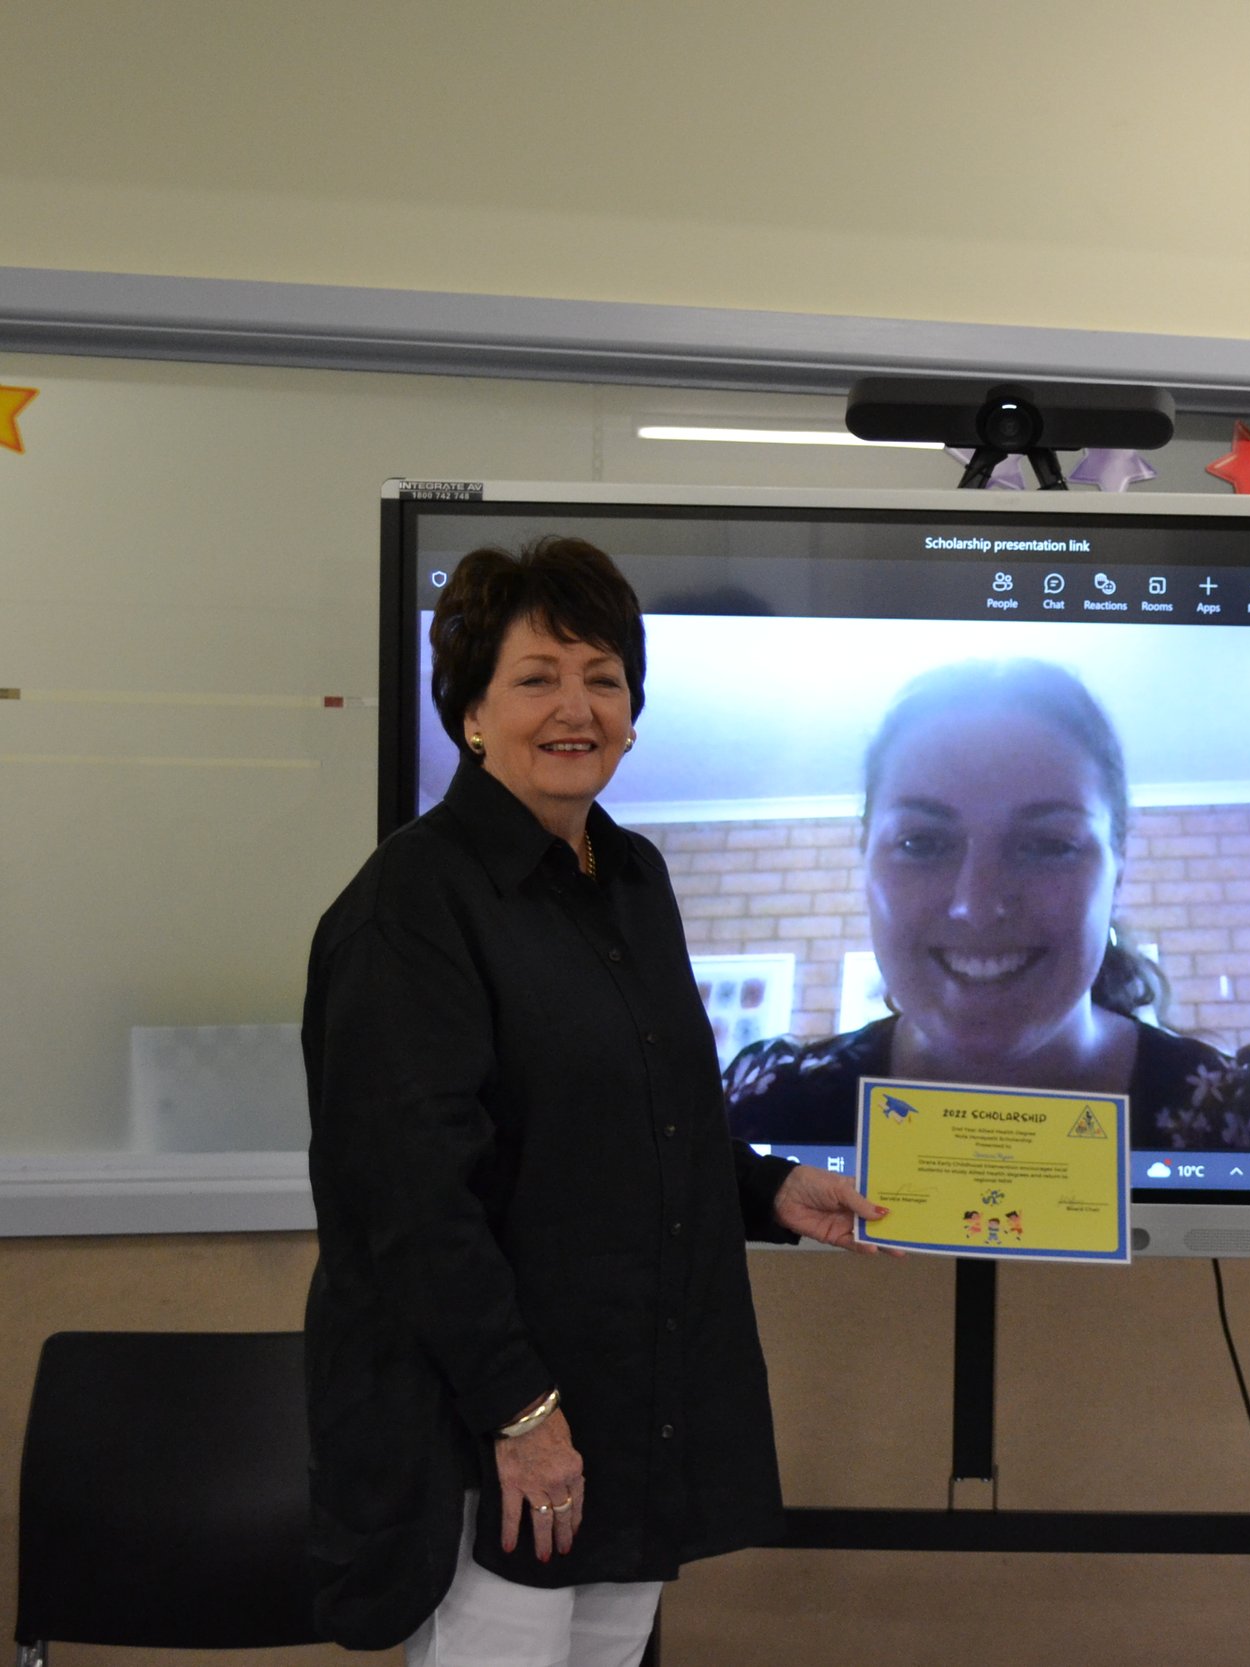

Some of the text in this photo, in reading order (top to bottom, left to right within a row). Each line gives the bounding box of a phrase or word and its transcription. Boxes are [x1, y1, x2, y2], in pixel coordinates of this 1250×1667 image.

[399, 482, 482, 491] INTEGRATE AV
[412, 491, 433, 500] 1800
[435, 491, 451, 500] 742
[924, 537, 1091, 552] Scholarship presentation link
[986, 598, 1019, 610] People
[1042, 599, 1065, 610] Chat
[1083, 600, 1129, 612] Reactions
[1141, 601, 1174, 612] Rooms
[1196, 602, 1222, 614] Apps
[942, 1108, 1048, 1124] 2022 SCHOLARSHIP
